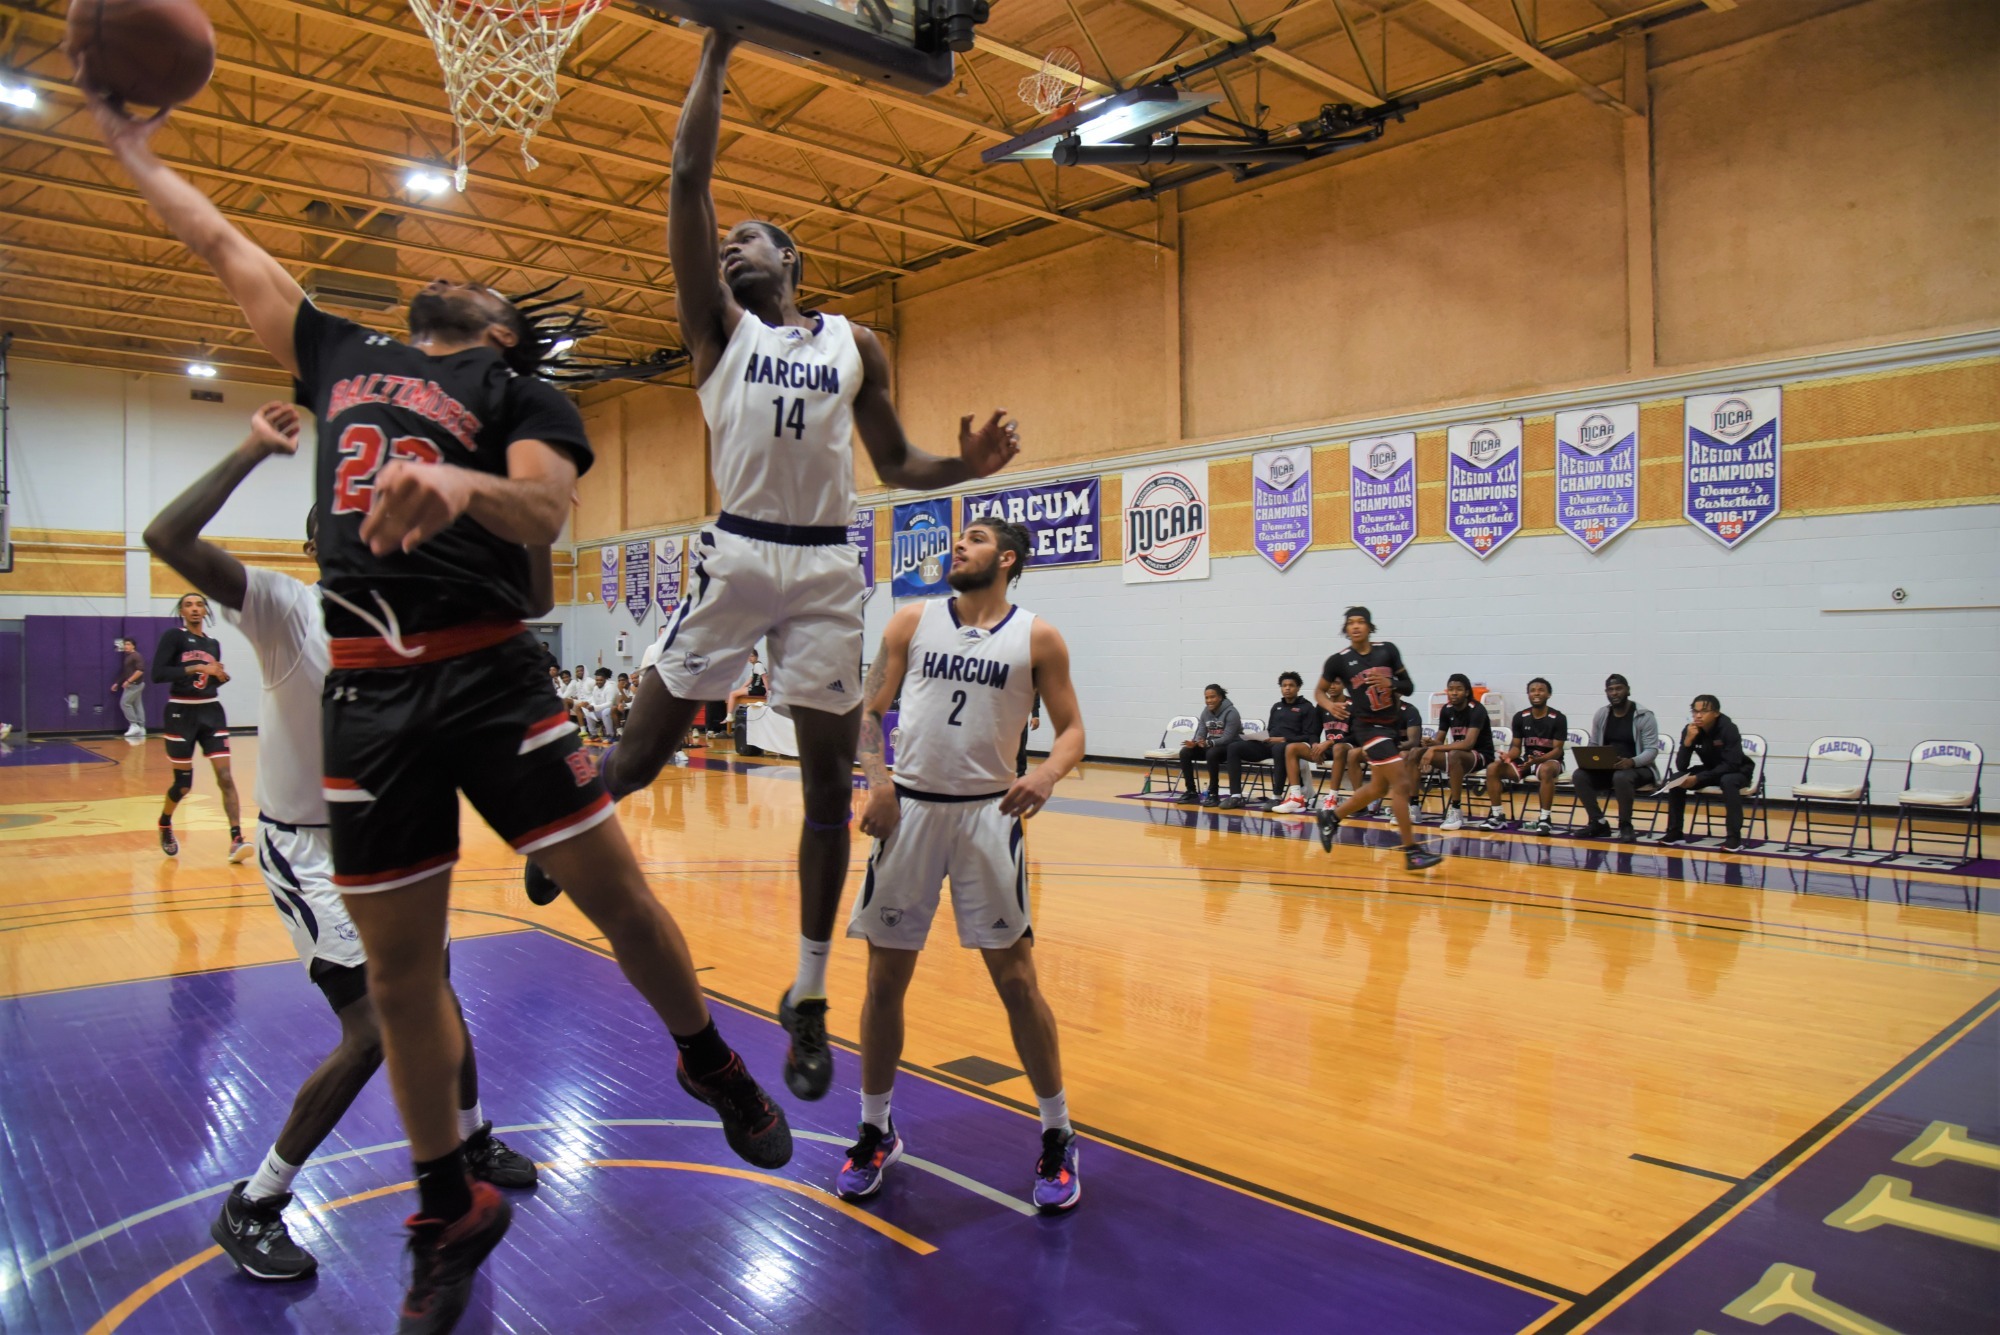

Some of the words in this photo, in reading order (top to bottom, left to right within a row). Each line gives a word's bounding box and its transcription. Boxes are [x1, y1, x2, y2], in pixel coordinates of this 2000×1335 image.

[744, 352, 839, 394] HARCUM
[772, 395, 805, 440] 14
[1713, 409, 1752, 432] NJCAA
[1580, 423, 1615, 444] NJCAA
[1469, 438, 1501, 457] NJCAA
[1692, 440, 1742, 465] REGION
[1748, 433, 1773, 461] XIX
[1369, 451, 1397, 470] NJCAA
[1561, 454, 1604, 476] REGION
[1610, 447, 1632, 471] XIX
[1270, 463, 1295, 481] NJCAA
[1453, 465, 1492, 486] REGION
[1497, 459, 1516, 483] XIX
[1690, 462, 1774, 483] CHAMPIONS
[1354, 477, 1390, 497] REGION
[1394, 471, 1411, 493] XIX
[1561, 473, 1633, 493] CHAMPIONS
[1700, 482, 1763, 497] Women's
[1136, 483, 1156, 506] NATIONAL
[1174, 480, 1193, 499] COLLEGE
[1256, 487, 1289, 507] REGION
[1292, 483, 1307, 503] XIX
[1452, 484, 1518, 502] CHAMPIONS
[1569, 491, 1623, 505] Women's
[1694, 494, 1770, 509] Basketball
[969, 488, 1091, 524] HARCUM
[1354, 494, 1412, 513] CHAMPIONS
[1459, 502, 1509, 514] Women's
[1564, 503, 1629, 517] Basketball
[1255, 505, 1309, 521] CHAMPIONS
[1361, 512, 1405, 524] Women's
[1454, 512, 1514, 525] Basketball
[1705, 510, 1757, 524] 2016-17
[1129, 503, 1203, 556] NJCAA
[1261, 519, 1302, 532] Women's
[1357, 522, 1410, 534] Basketball
[1464, 526, 1503, 538] 2010-11
[1573, 518, 1618, 531] 2012-13
[1720, 524, 1741, 535] 25-8
[1258, 530, 1306, 541] Basketball
[1364, 534, 1403, 546] 2009-10
[895, 528, 948, 577] NJCAA
[1266, 542, 1296, 552] 2006
[922, 651, 1010, 690] HARCUM
[947, 690, 967, 726] 2
[1818, 741, 1863, 757] HARCUM
[1921, 745, 1972, 761] HARCUM
